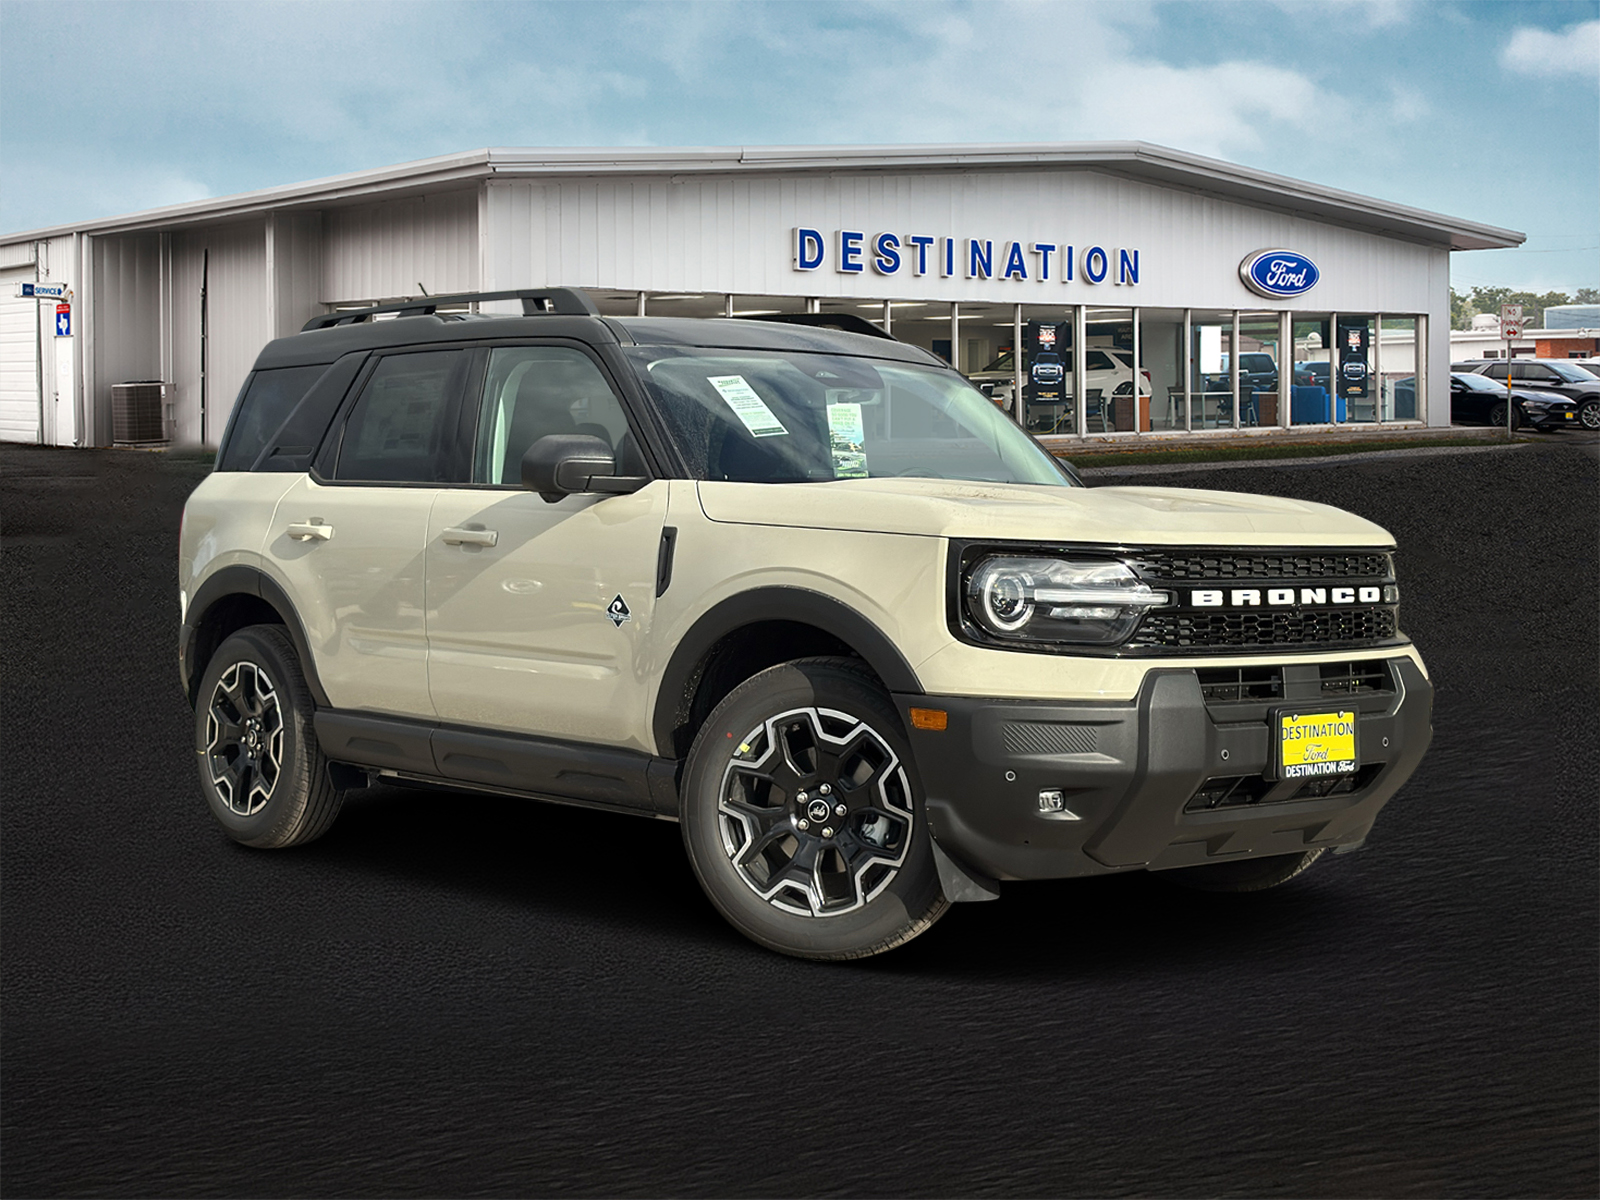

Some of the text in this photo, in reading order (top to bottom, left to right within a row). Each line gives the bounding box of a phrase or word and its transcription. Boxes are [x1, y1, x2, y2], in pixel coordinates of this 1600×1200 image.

[792, 227, 1140, 286] DESTINATION
[1266, 260, 1307, 287] Ford
[35, 286, 57, 296] SERVICE
[1507, 308, 1517, 316] NO
[1502, 319, 1521, 327] PARKING
[1191, 587, 1380, 606] BRONCO
[1282, 722, 1354, 741] DESTINATION
[1303, 743, 1329, 761] Ford
[1286, 762, 1337, 778] DESTINATION
